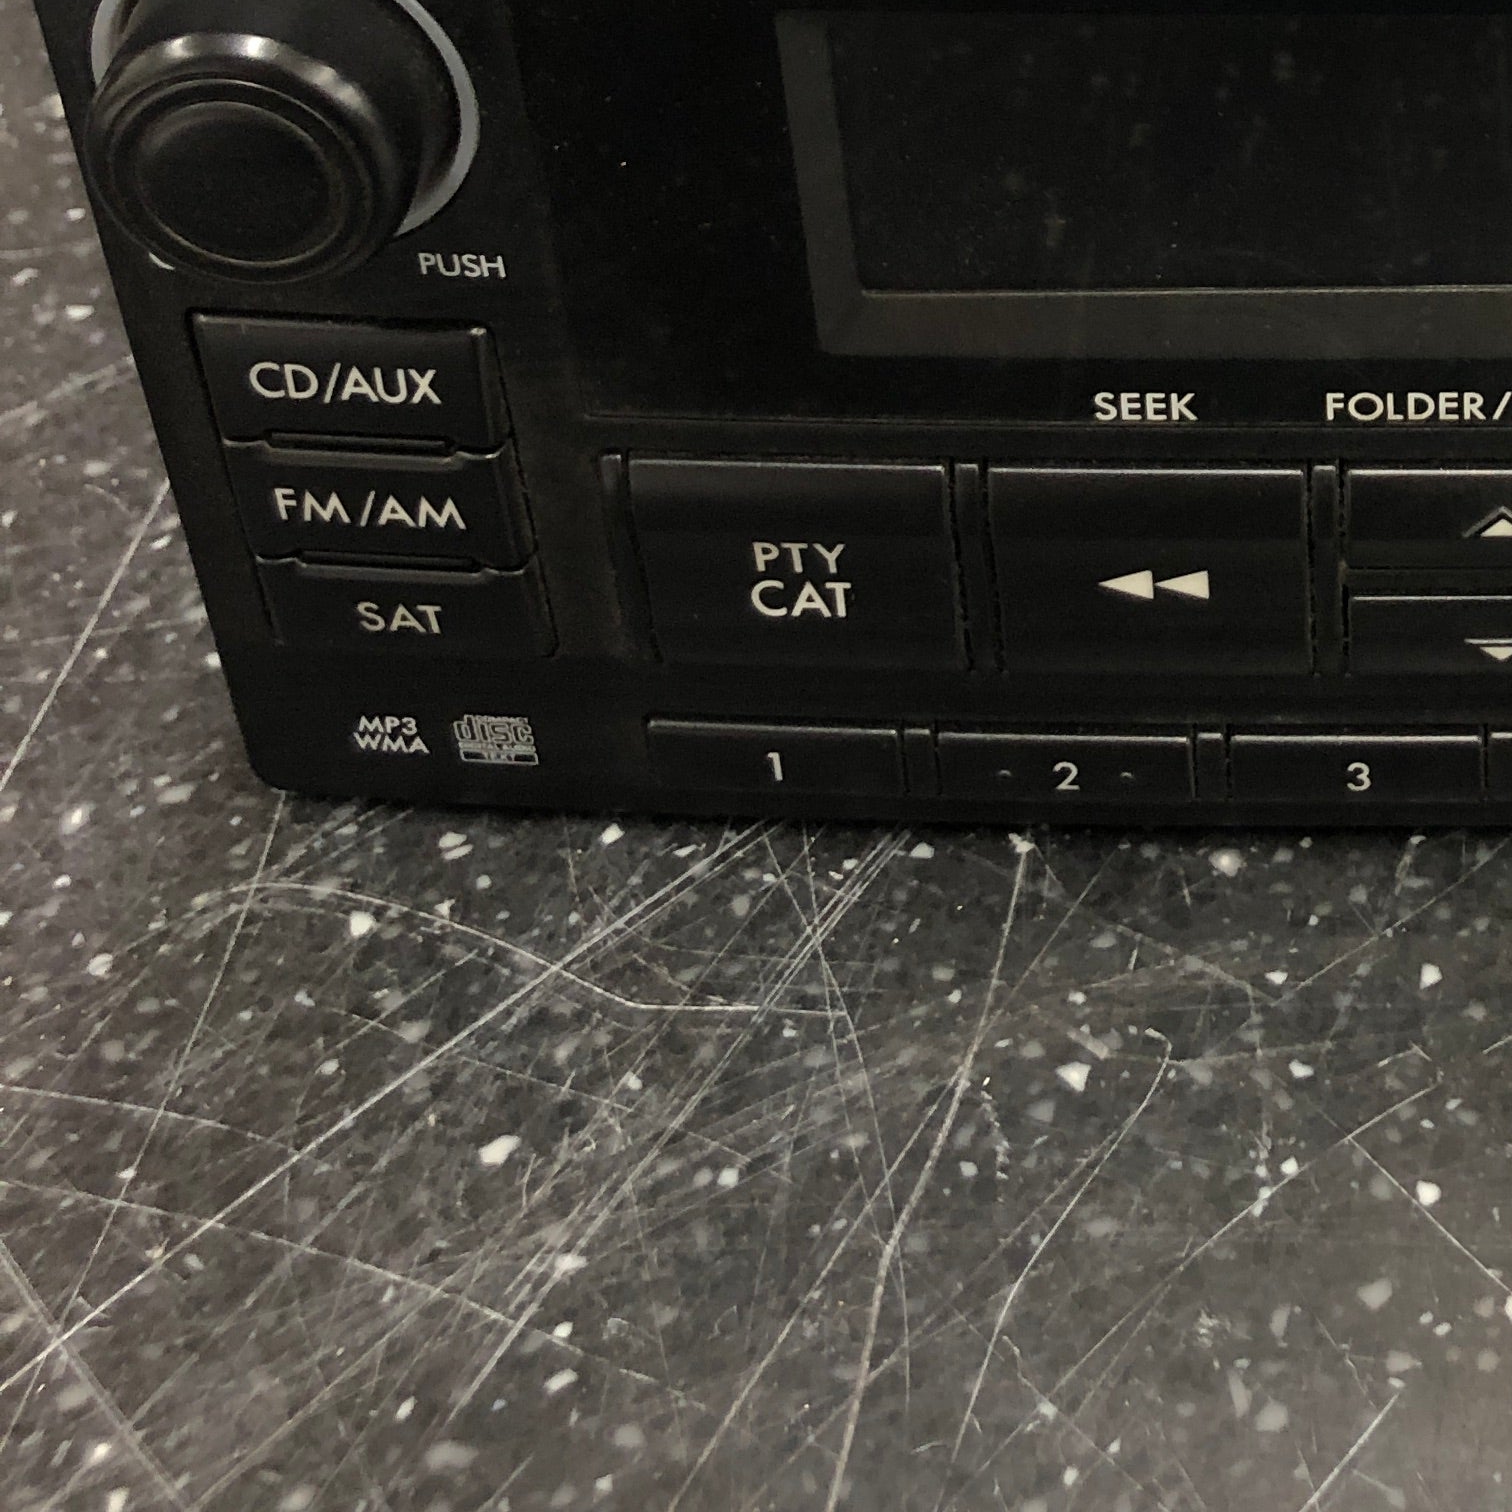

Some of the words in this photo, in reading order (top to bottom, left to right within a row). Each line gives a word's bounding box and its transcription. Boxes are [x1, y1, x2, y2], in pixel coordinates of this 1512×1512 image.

[419, 253, 507, 279] PUSH
[249, 362, 442, 405] CD/AUX
[1094, 392, 1198, 422] SEEK
[274, 488, 467, 530] FM/AM
[752, 542, 846, 574] PTY
[751, 580, 852, 619] CAT
[357, 602, 443, 634] SAT
[358, 715, 418, 736] MP3
[353, 731, 431, 755] WMA
[766, 752, 784, 783] 1
[1053, 762, 1081, 791] 2
[1346, 762, 1372, 793] 3
